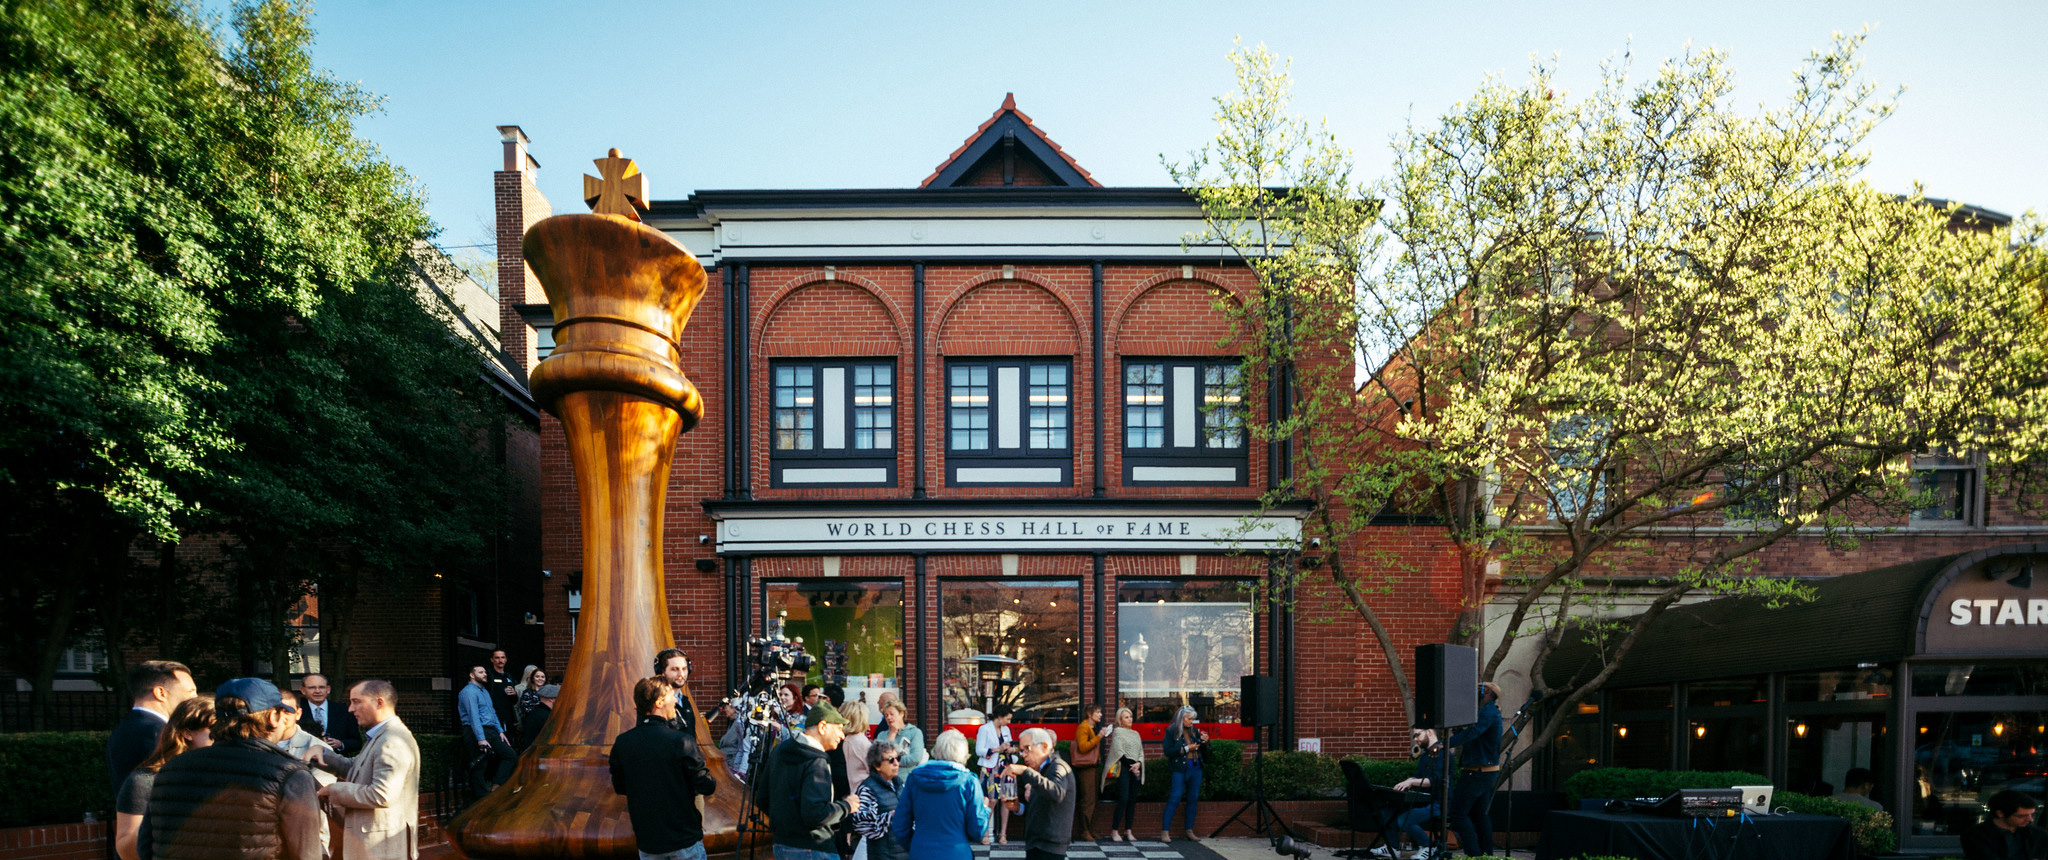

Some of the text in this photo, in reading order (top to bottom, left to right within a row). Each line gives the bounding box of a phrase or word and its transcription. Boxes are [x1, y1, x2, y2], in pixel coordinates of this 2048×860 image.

[827, 522, 912, 536] WORLD
[925, 522, 1005, 536] CHESS
[1022, 522, 1083, 535] HALL
[1126, 522, 1190, 535] FAME
[1950, 599, 2048, 626] STAR
